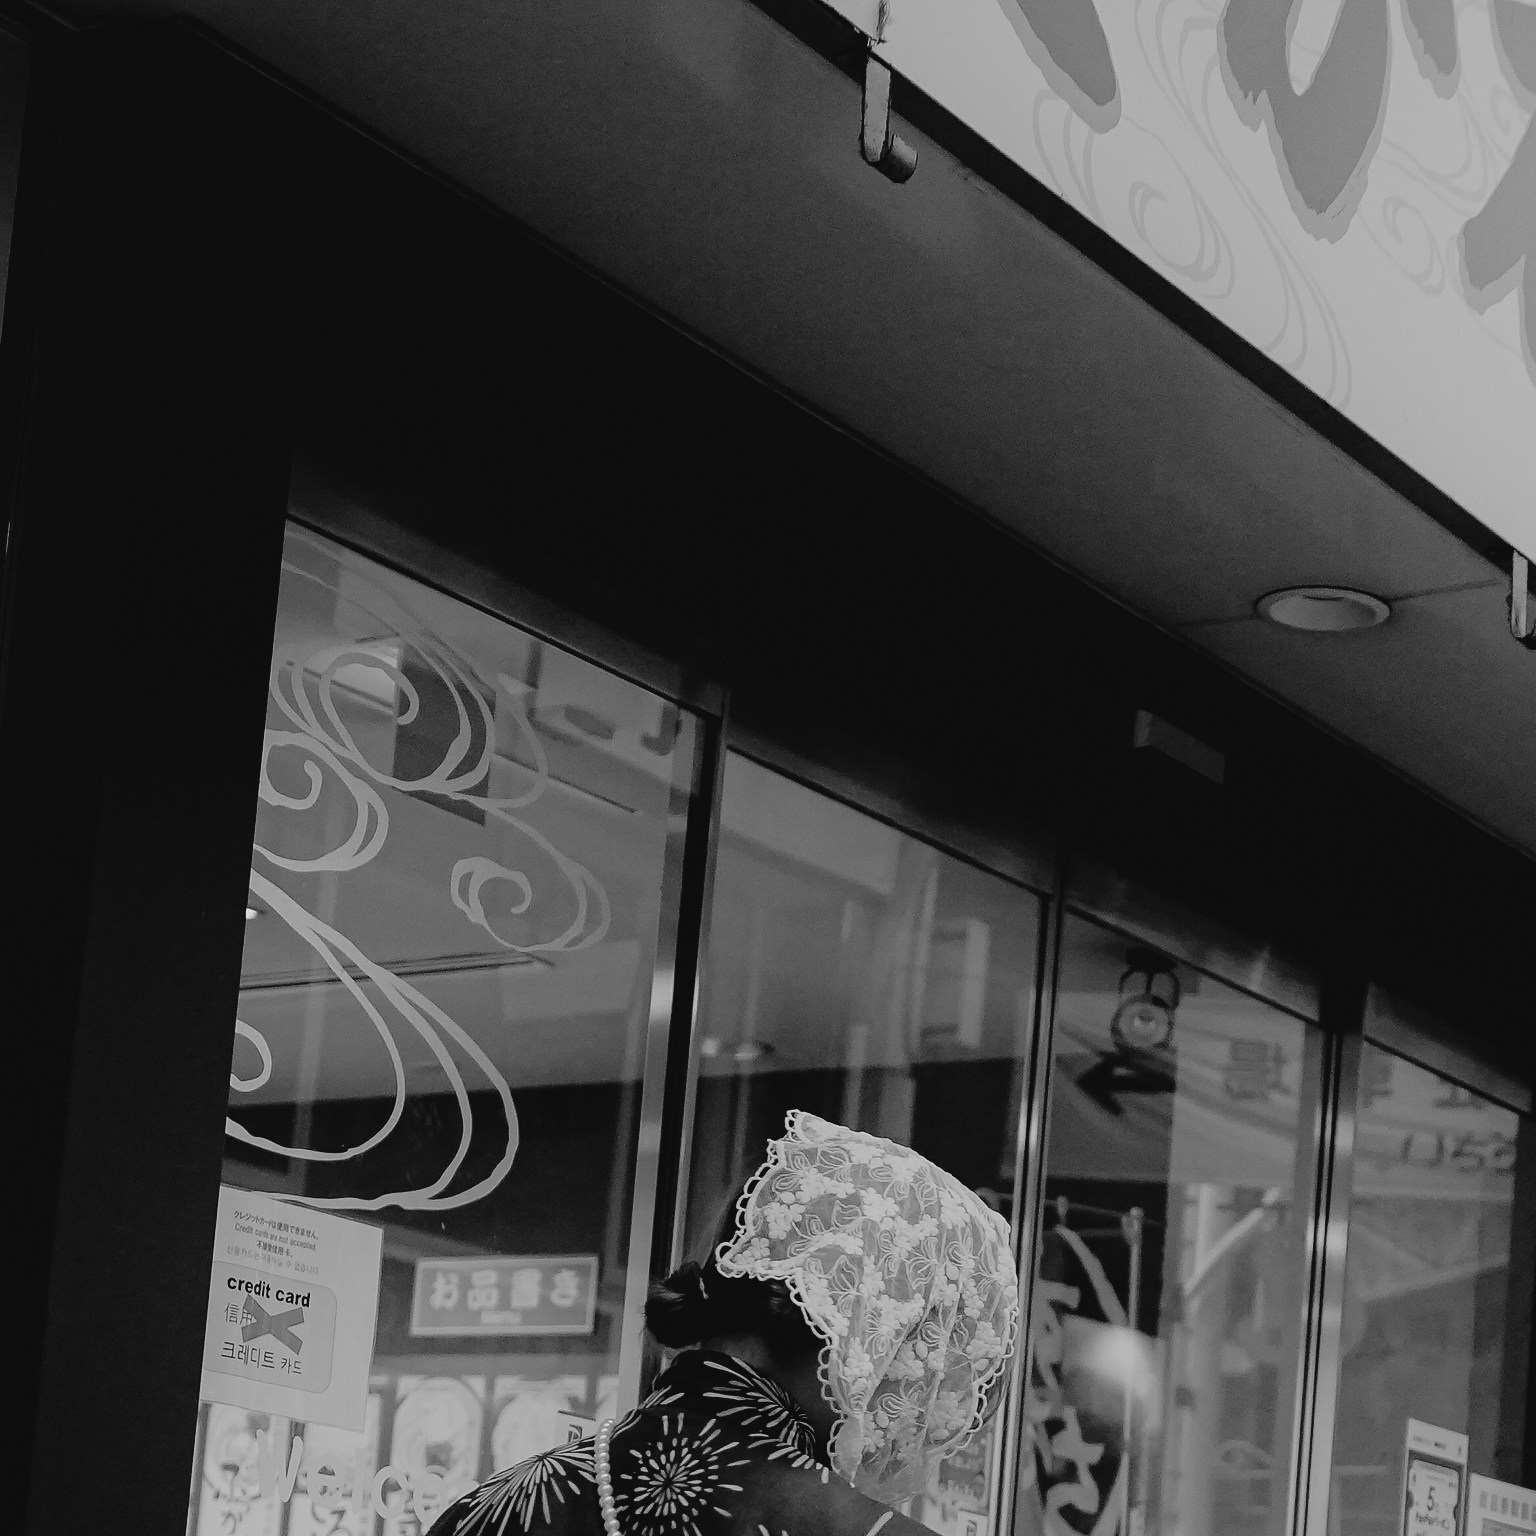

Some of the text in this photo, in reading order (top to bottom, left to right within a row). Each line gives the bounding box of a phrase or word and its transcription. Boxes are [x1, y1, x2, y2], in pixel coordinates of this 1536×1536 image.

[234, 1223, 253, 1234] Credit
[279, 1235, 288, 1244] not
[227, 1276, 311, 1307] credit card
[221, 1341, 302, 1375] 크레디트 카드
[256, 1429, 479, 1530] Welco
